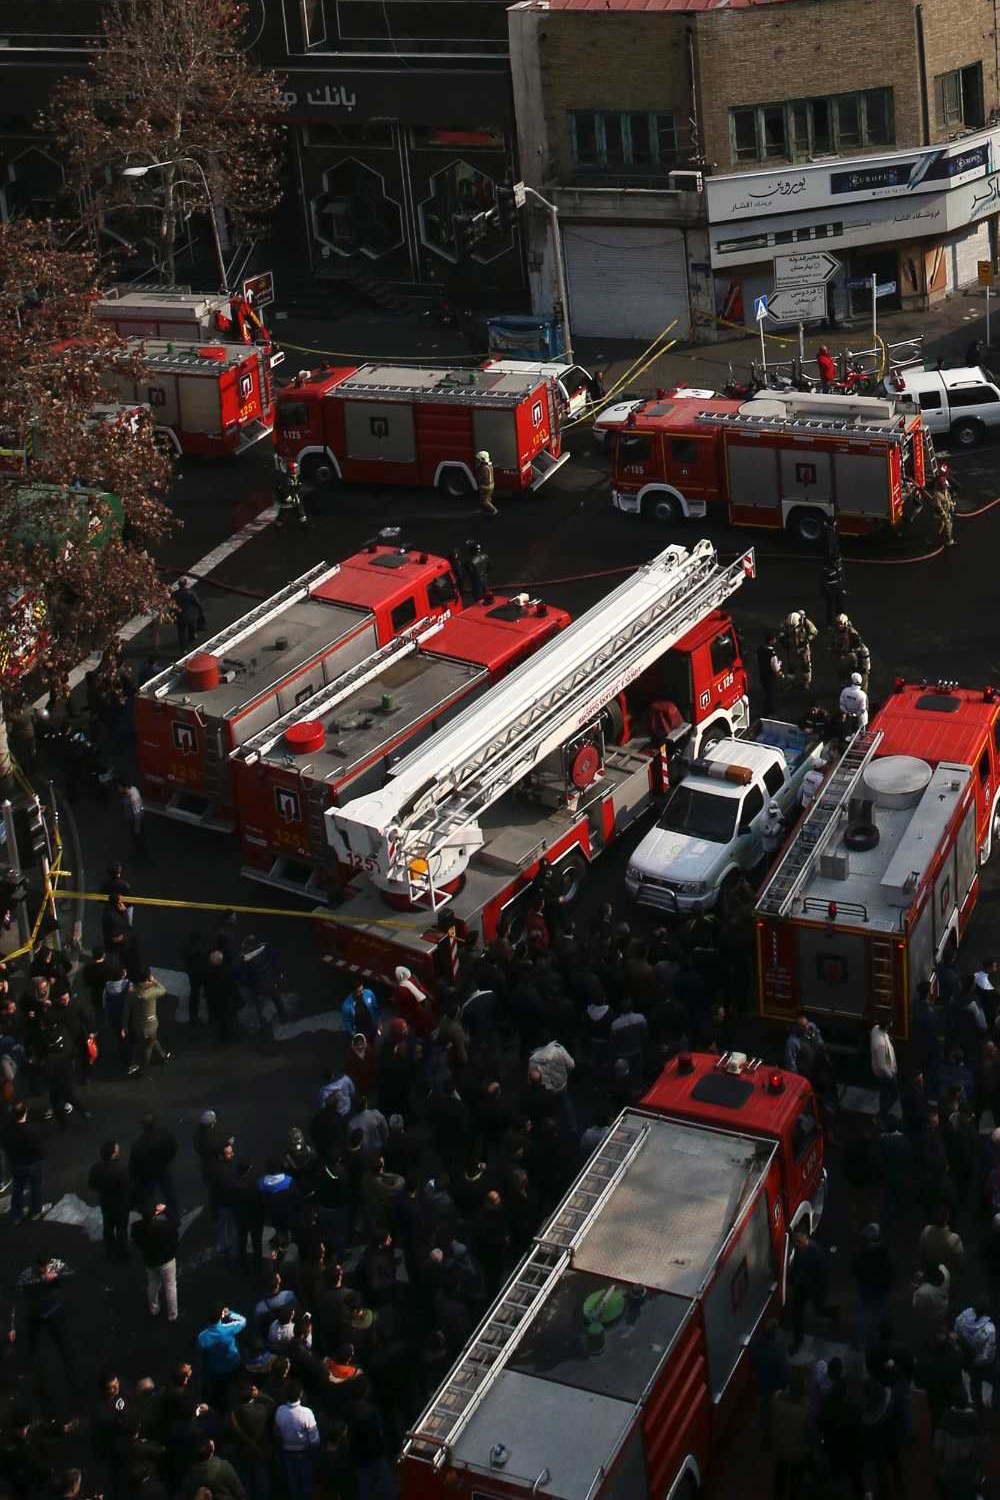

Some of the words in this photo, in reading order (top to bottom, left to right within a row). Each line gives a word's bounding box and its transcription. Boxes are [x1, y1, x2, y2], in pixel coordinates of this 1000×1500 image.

[240, 403, 253, 417] 125
[723, 672, 734, 690] 125
[347, 852, 374, 871] 125
